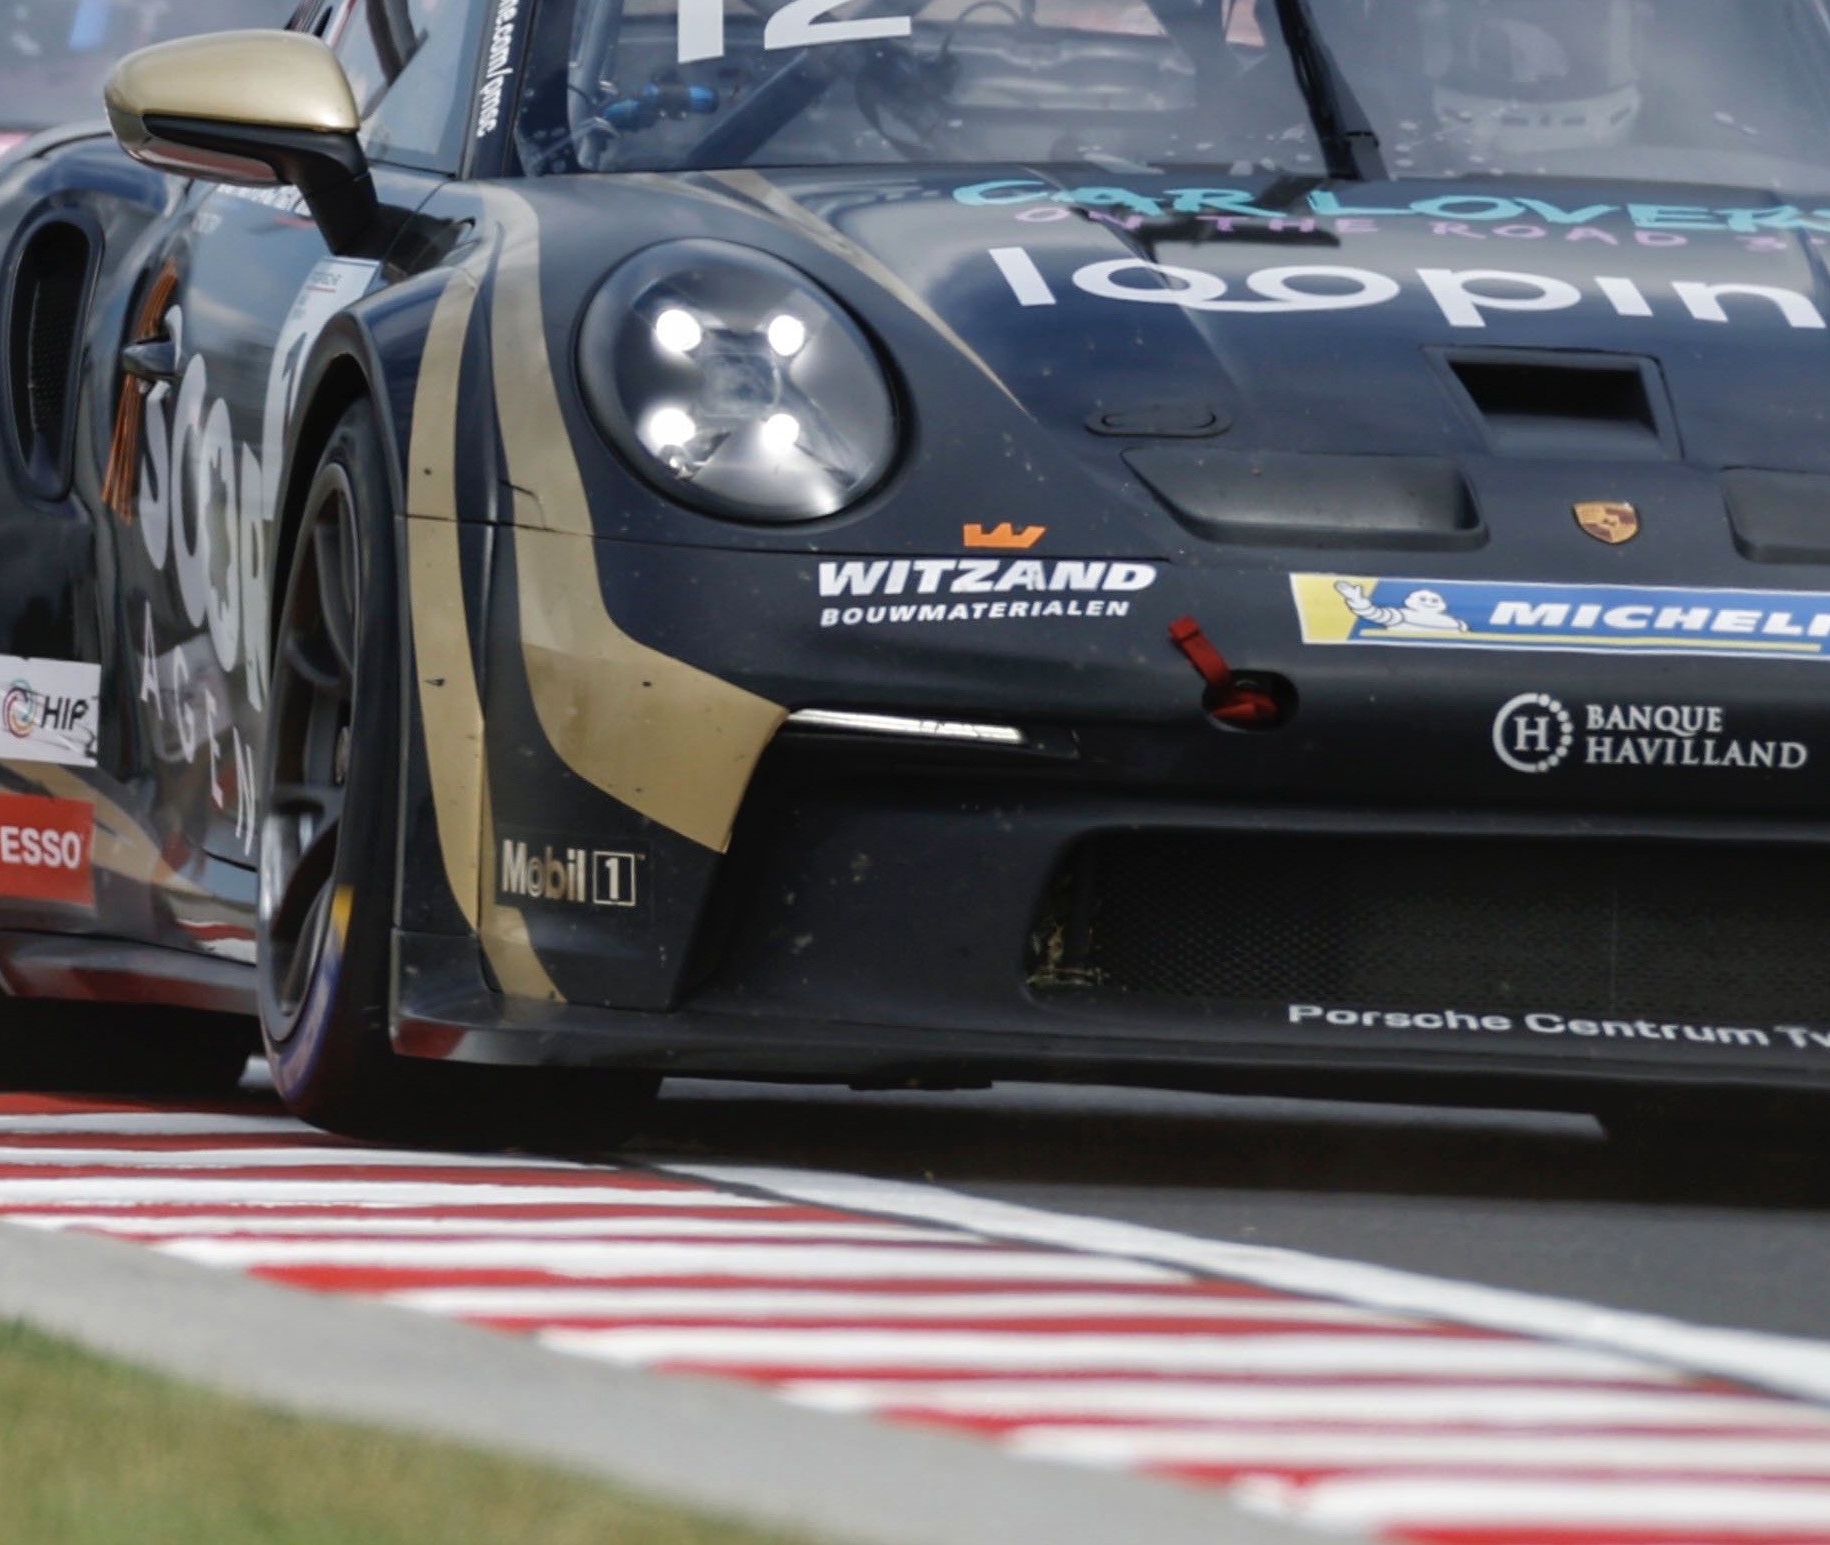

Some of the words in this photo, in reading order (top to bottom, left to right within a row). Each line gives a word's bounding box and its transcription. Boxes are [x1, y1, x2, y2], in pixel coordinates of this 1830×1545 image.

[952, 179, 1288, 218] CAR
[1014, 206, 1143, 231] ON
[1195, 214, 1379, 234] THE
[1425, 220, 1689, 249] ROAD
[818, 559, 1157, 598] WITZAND
[820, 599, 1131, 627] BOUWMATERIALEN
[1584, 704, 1724, 738] BANQUE
[1584, 737, 1808, 770] HAVILLAND
[0, 826, 81, 869] ESSO
[502, 838, 586, 903] Mobil
[1287, 1002, 1512, 1033] Porsche
[1524, 1011, 1769, 1048] Centrum
